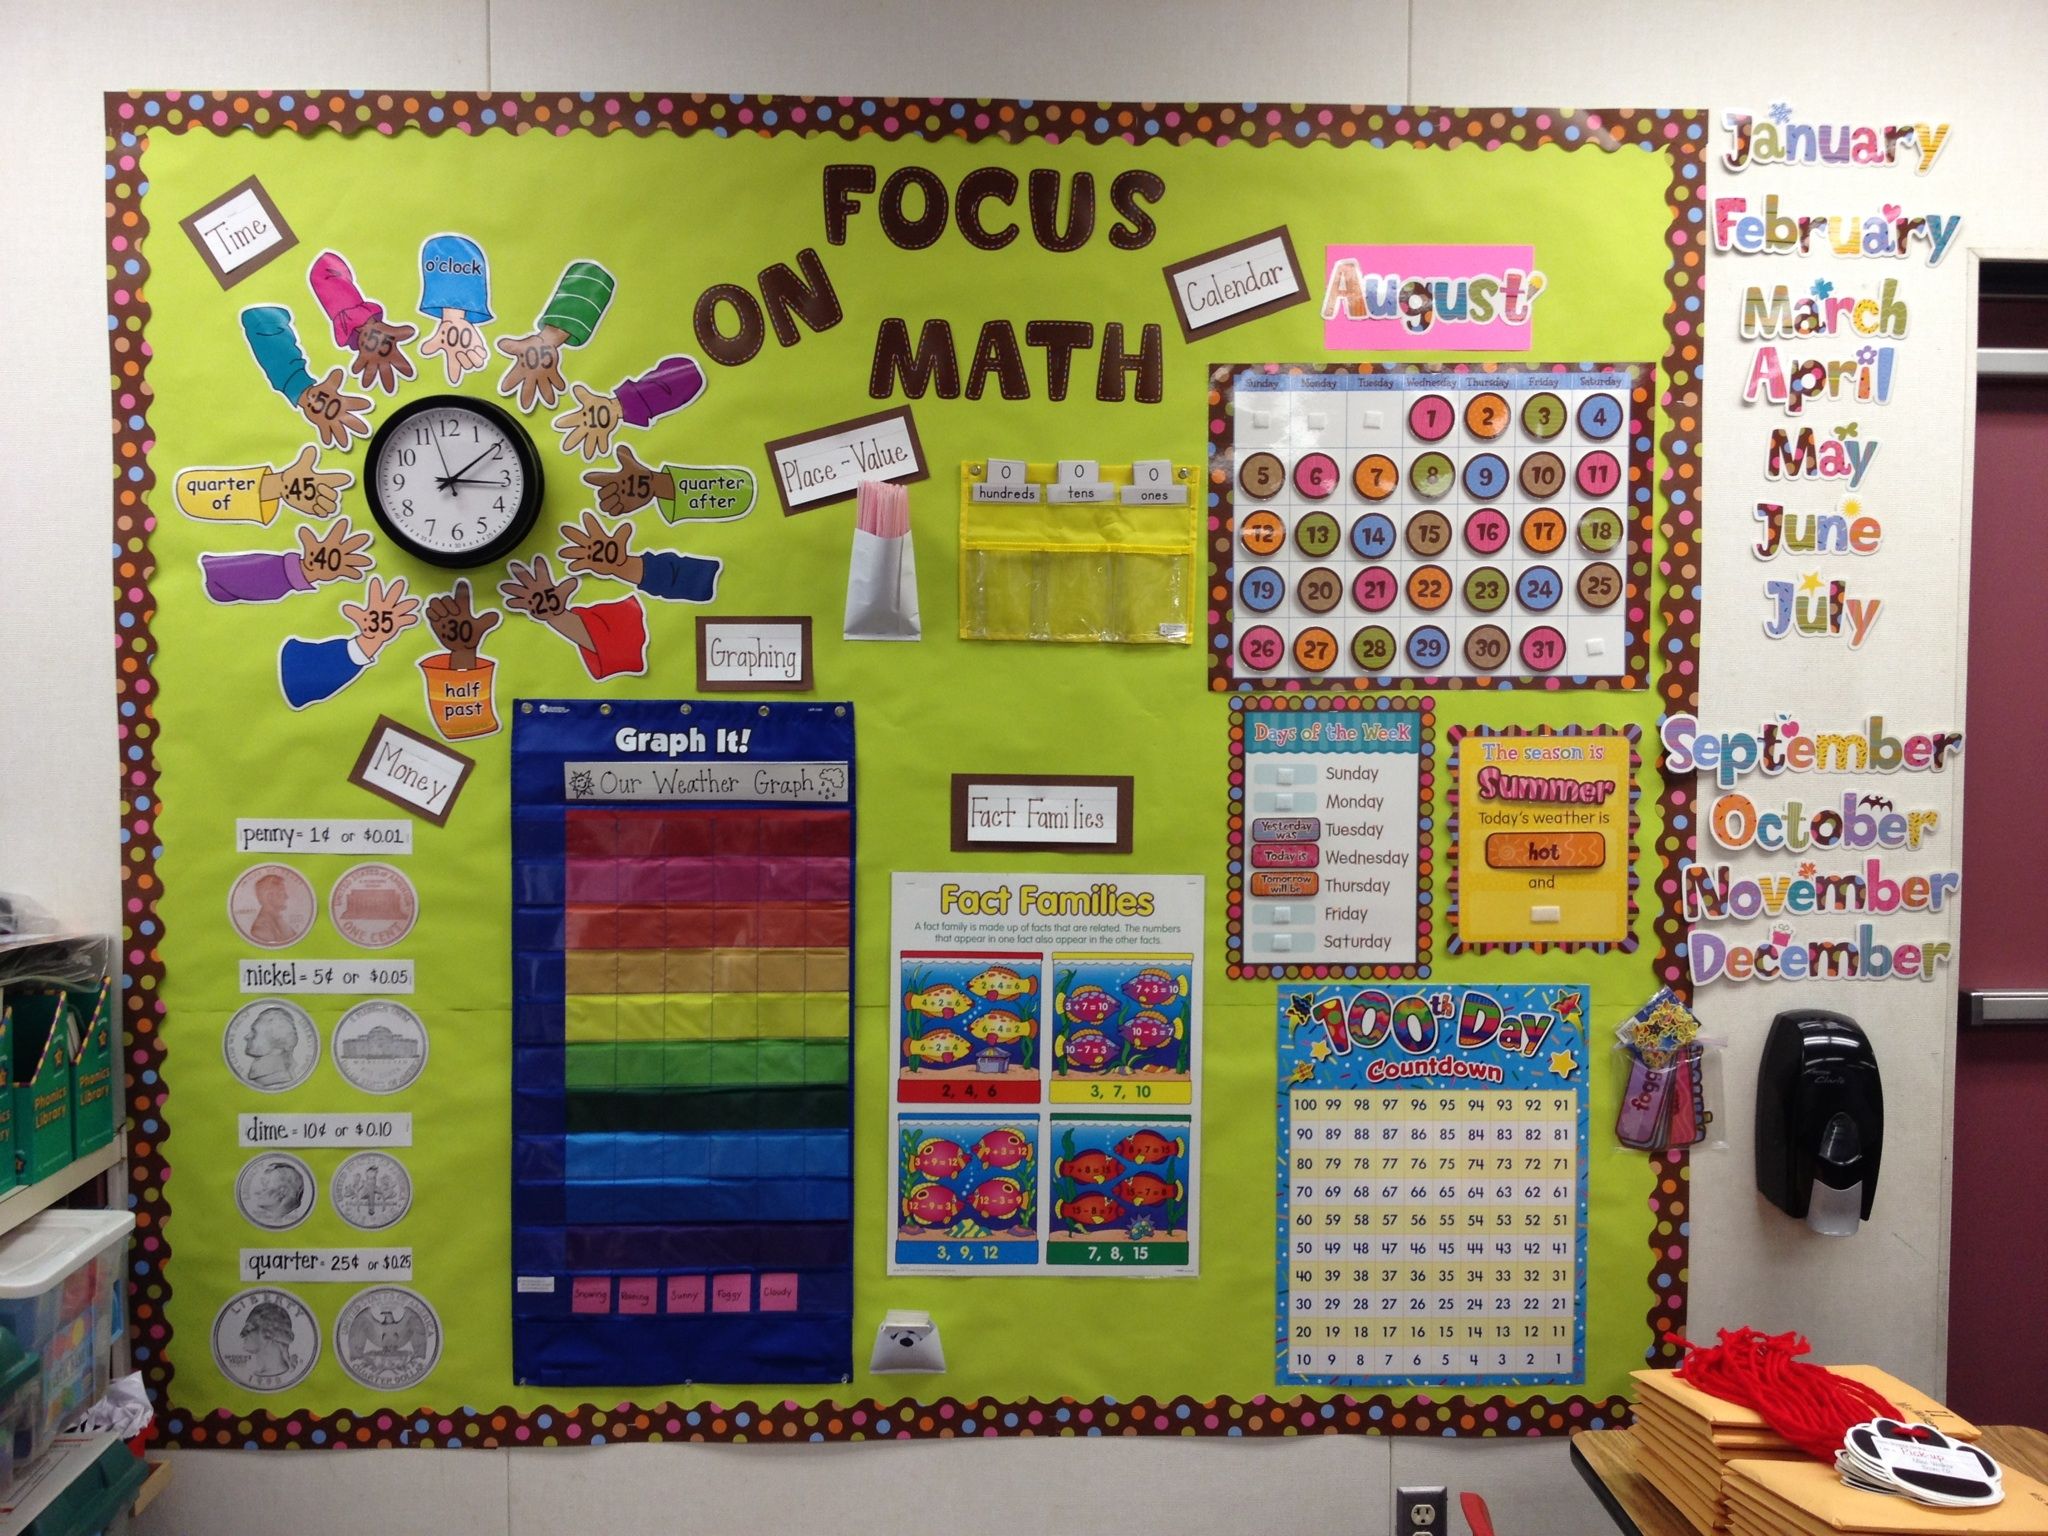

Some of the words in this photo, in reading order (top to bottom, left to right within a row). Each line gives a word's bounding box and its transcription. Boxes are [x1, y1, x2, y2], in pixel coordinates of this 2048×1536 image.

[1725, 113, 1950, 173] January
[823, 164, 1165, 253] FOCUS
[204, 217, 267, 255] Time
[1714, 195, 1961, 264] February
[426, 256, 482, 276] o'clock
[1186, 260, 1284, 313] Calendar
[1322, 258, 1530, 333] August
[693, 247, 843, 367] ON
[1743, 278, 1909, 336] March
[440, 326, 473, 349] :00
[520, 346, 554, 370] :05
[868, 317, 1163, 404] MATH
[1246, 378, 1280, 389] Sunday
[1302, 378, 1337, 389] Monday
[1358, 378, 1394, 389] Tuesday
[1407, 377, 1457, 388] Wednesday
[1467, 377, 1510, 388] Thursday
[1528, 377, 1559, 388] Friday
[1580, 376, 1622, 387] Saturday
[1745, 346, 1895, 413] April
[308, 391, 342, 420] :50
[582, 405, 611, 428] :10
[1426, 410, 1437, 428] 1
[1482, 407, 1494, 426] 2
[1538, 407, 1551, 425] 3
[1593, 408, 1607, 426] 4
[439, 419, 460, 437] 12
[1766, 427, 1879, 488] May
[1001, 465, 1011, 479] 0
[1074, 464, 1084, 478] 0
[1149, 467, 1159, 481] 0
[187, 477, 256, 493] quarter
[284, 477, 316, 500] :45
[621, 475, 651, 498] :15
[679, 475, 744, 490] quarter
[979, 485, 1035, 499] hundreds
[1068, 485, 1094, 498] tens
[212, 495, 232, 510] of
[689, 494, 736, 509] after
[1141, 491, 1168, 500] ones
[451, 523, 464, 540] 6
[1756, 503, 1882, 556] June
[310, 547, 341, 571] :40
[588, 540, 619, 564] :20
[528, 588, 561, 615] :25
[363, 611, 393, 633] :35
[1766, 580, 1882, 646] July
[441, 620, 473, 643] :30
[711, 637, 796, 678] Graphing
[445, 682, 480, 698] half
[445, 704, 483, 720] past
[615, 727, 706, 757] Graph
[716, 728, 751, 754] It!
[1254, 723, 1296, 746] Days
[1301, 723, 1321, 742] of
[1326, 723, 1357, 742] the
[1482, 743, 1518, 761] The
[1524, 745, 1584, 761] season
[1590, 744, 1604, 760] is
[1663, 715, 1963, 786] September
[374, 742, 446, 804] Money
[600, 770, 643, 794] Our
[652, 768, 739, 795] Weather
[754, 769, 814, 797] Graph
[1326, 765, 1379, 783] Sunday
[1478, 765, 1616, 805] Summer
[970, 796, 1016, 830] Fact
[1027, 797, 1104, 830] Families
[1326, 794, 1384, 812] Monday
[1261, 821, 1312, 832] Yesterday
[1479, 810, 1529, 826] Today's
[1534, 811, 1595, 824] weather
[1599, 811, 1609, 823] is
[1712, 792, 1940, 849] October
[341, 831, 355, 842] or
[364, 828, 404, 844] $0.01
[1276, 831, 1297, 840] was
[1326, 822, 1384, 840] Tuesday
[1265, 851, 1296, 862] Today
[1298, 851, 1307, 860] is
[1326, 850, 1409, 868] Wednesday
[1528, 842, 1560, 860] hot
[1261, 874, 1311, 883] Tomorrow
[1271, 884, 1287, 893] will
[1326, 877, 1390, 896] Thursday
[1528, 875, 1555, 889] and
[1685, 858, 1960, 918] November
[940, 883, 1012, 916] Fact
[1018, 883, 1155, 917] Families
[1325, 906, 1368, 923] Friday
[914, 922, 921, 930] A
[923, 921, 939, 931] fact
[941, 921, 967, 933] family
[970, 922, 977, 931] is
[979, 922, 1004, 932] made
[1006, 923, 1018, 933] up
[1020, 922, 1030, 932] of
[1031, 922, 1051, 932] facts
[1054, 923, 1070, 932] that
[1073, 924, 1087, 933] are
[1124, 923, 1140, 933] The
[1142, 923, 1181, 933] numbers
[935, 933, 952, 943] that
[954, 935, 985, 945] appear
[988, 934, 996, 943] in
[998, 935, 1014, 944] one
[1017, 934, 1033, 944] fact
[1035, 934, 1053, 944] also
[1055, 936, 1087, 946] appear
[1089, 935, 1097, 944] in
[1099, 935, 1113, 944] the
[1115, 935, 1137, 945] other
[1324, 934, 1391, 952] Saturday
[1690, 924, 1952, 983] December
[312, 969, 333, 986] 5¢
[343, 971, 360, 983] or
[369, 969, 408, 984] $0.05
[1456, 990, 1555, 1057] Day
[1366, 1055, 1504, 1084] Countdown
[35, 1088, 66, 1110] Phonics
[1631, 1071, 1662, 1111] fogg
[1294, 1099, 1317, 1112] 100
[1325, 1099, 1342, 1112] 99
[1354, 1099, 1370, 1112] 98
[1382, 1099, 1398, 1112] 97
[37, 1105, 65, 1128] Library
[303, 1122, 326, 1138] 10¢
[335, 1126, 349, 1137] or
[355, 1121, 392, 1137] $0.10
[331, 1255, 360, 1271] 25¢
[368, 1259, 379, 1270] or
[383, 1255, 411, 1271] $0.25
[671, 1291, 699, 1302] Sunny
[717, 1290, 742, 1301] Foggy
[764, 1287, 792, 1298] Cloudy
